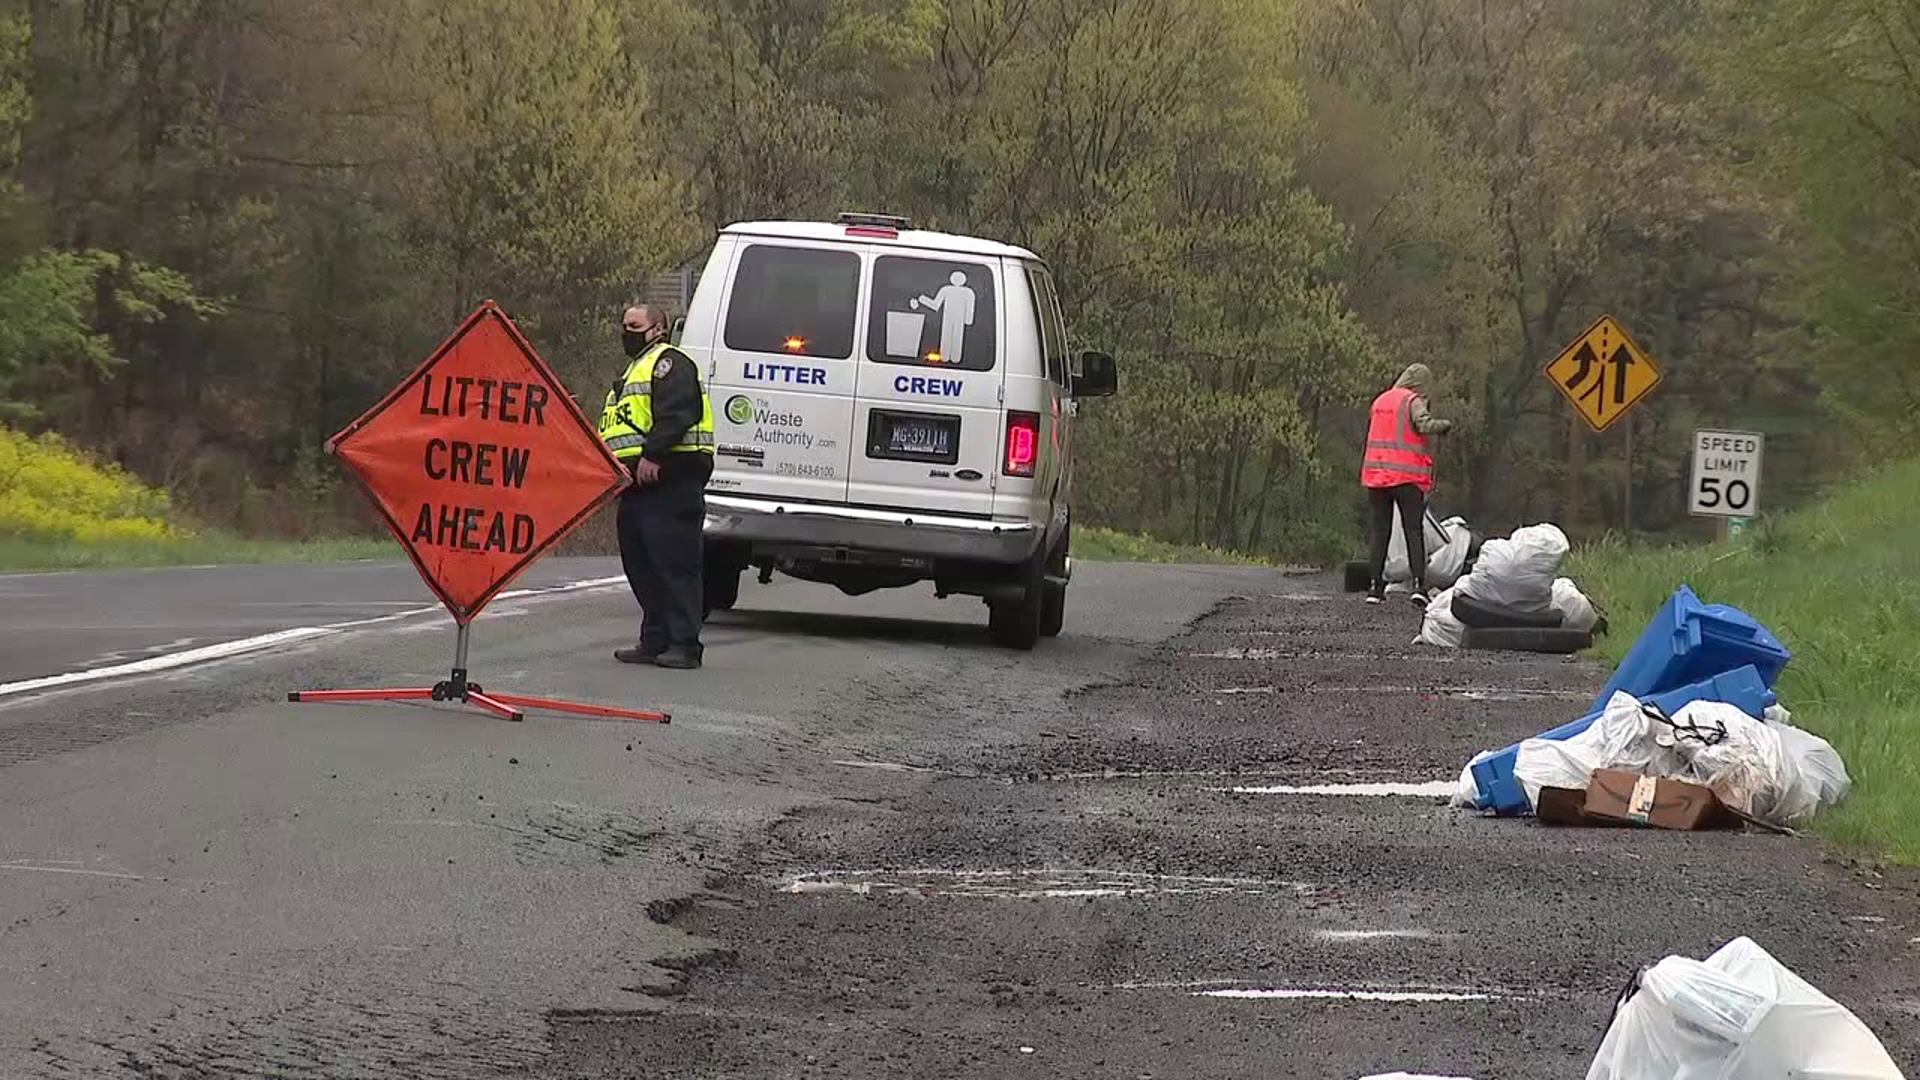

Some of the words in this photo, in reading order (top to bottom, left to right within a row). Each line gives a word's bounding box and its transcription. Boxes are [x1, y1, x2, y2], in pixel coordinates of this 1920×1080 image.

[743, 362, 827, 385] LITTER
[894, 375, 964, 397] CREW
[420, 375, 549, 426] LITTER
[756, 398, 769, 408] The
[600, 402, 633, 433] OLICE
[753, 408, 803, 427] Waste
[754, 427, 814, 449] Authority
[1700, 437, 1756, 453] SPEED
[424, 438, 530, 489] CREW
[776, 462, 796, 476] (570)
[797, 464, 835, 478] 643-6100
[1704, 458, 1748, 472] LIMIT
[1698, 477, 1749, 509] 50
[411, 503, 536, 554] AHEAD
